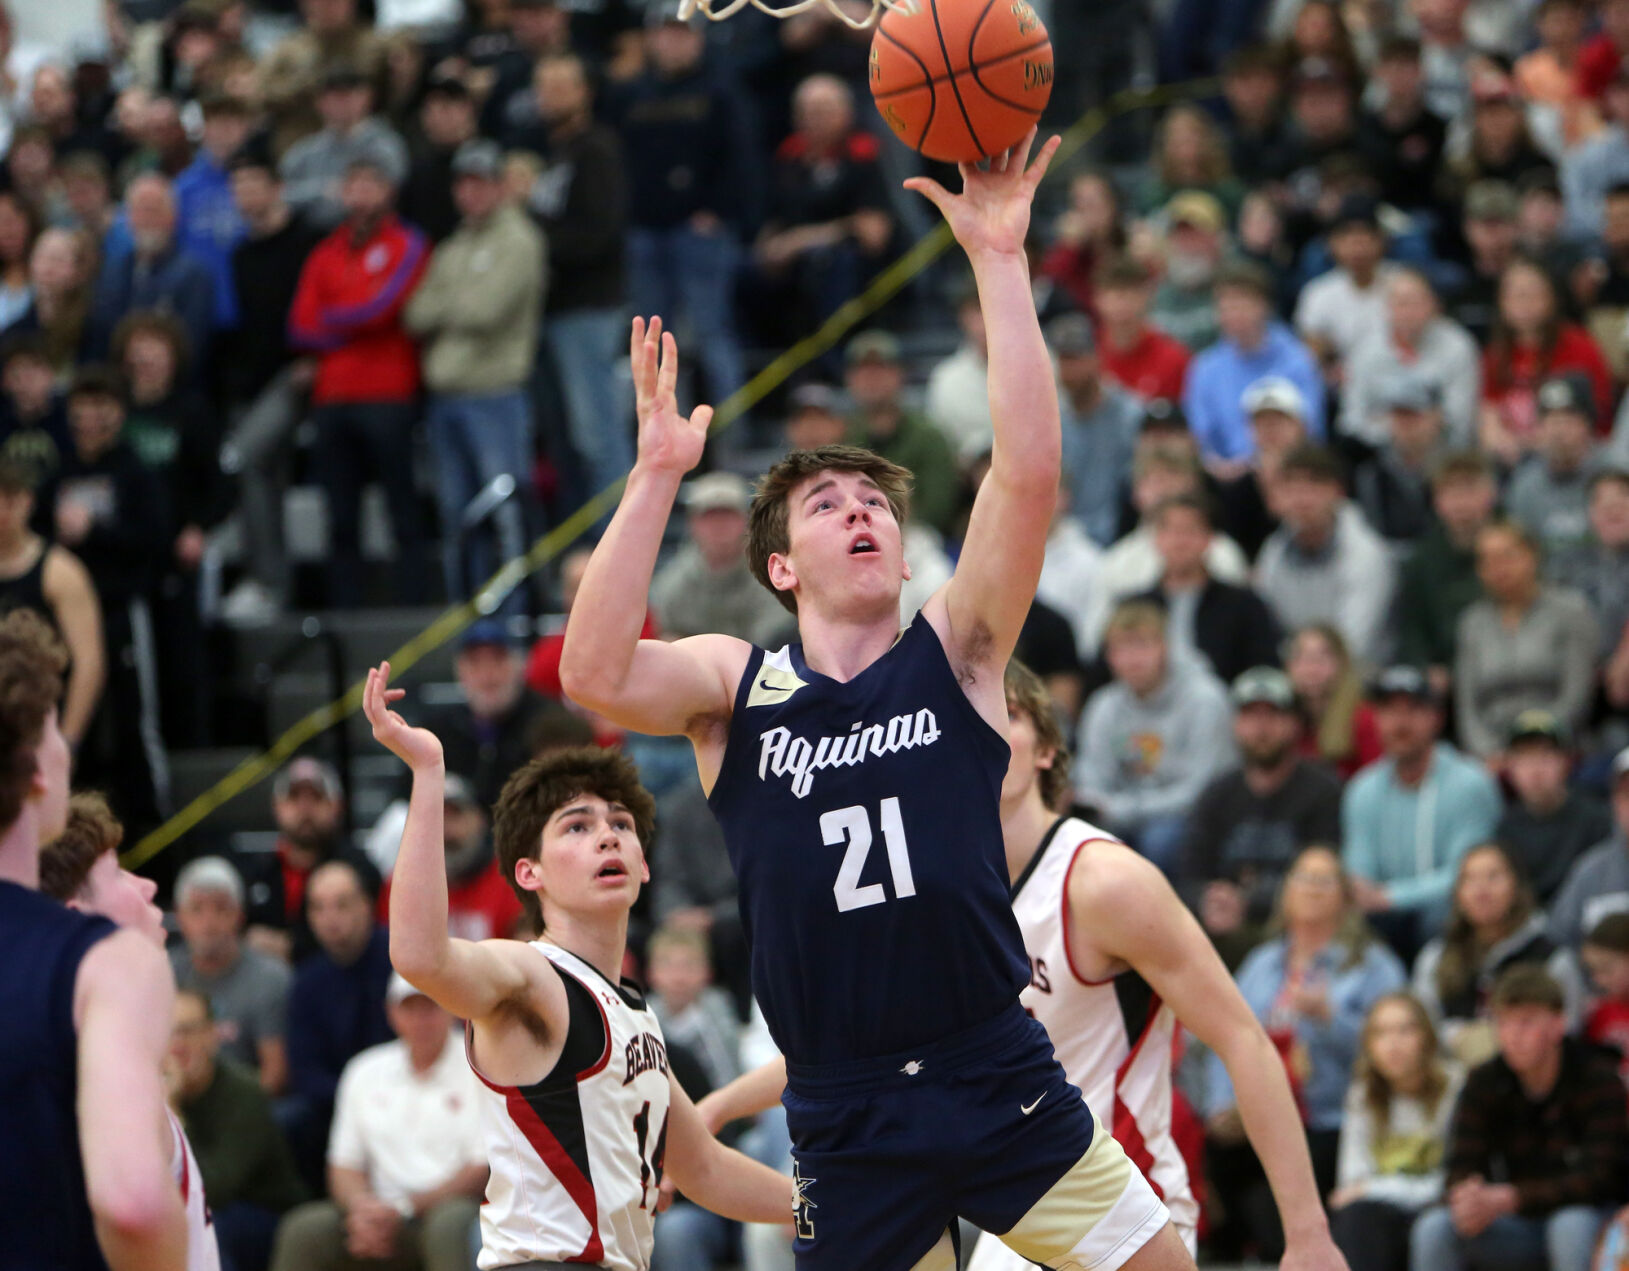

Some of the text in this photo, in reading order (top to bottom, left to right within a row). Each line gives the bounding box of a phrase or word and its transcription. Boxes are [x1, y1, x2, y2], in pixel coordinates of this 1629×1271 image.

[758, 708, 942, 800] Aquinas
[819, 796, 917, 913] 21
[622, 1031, 669, 1087] BEAVE
